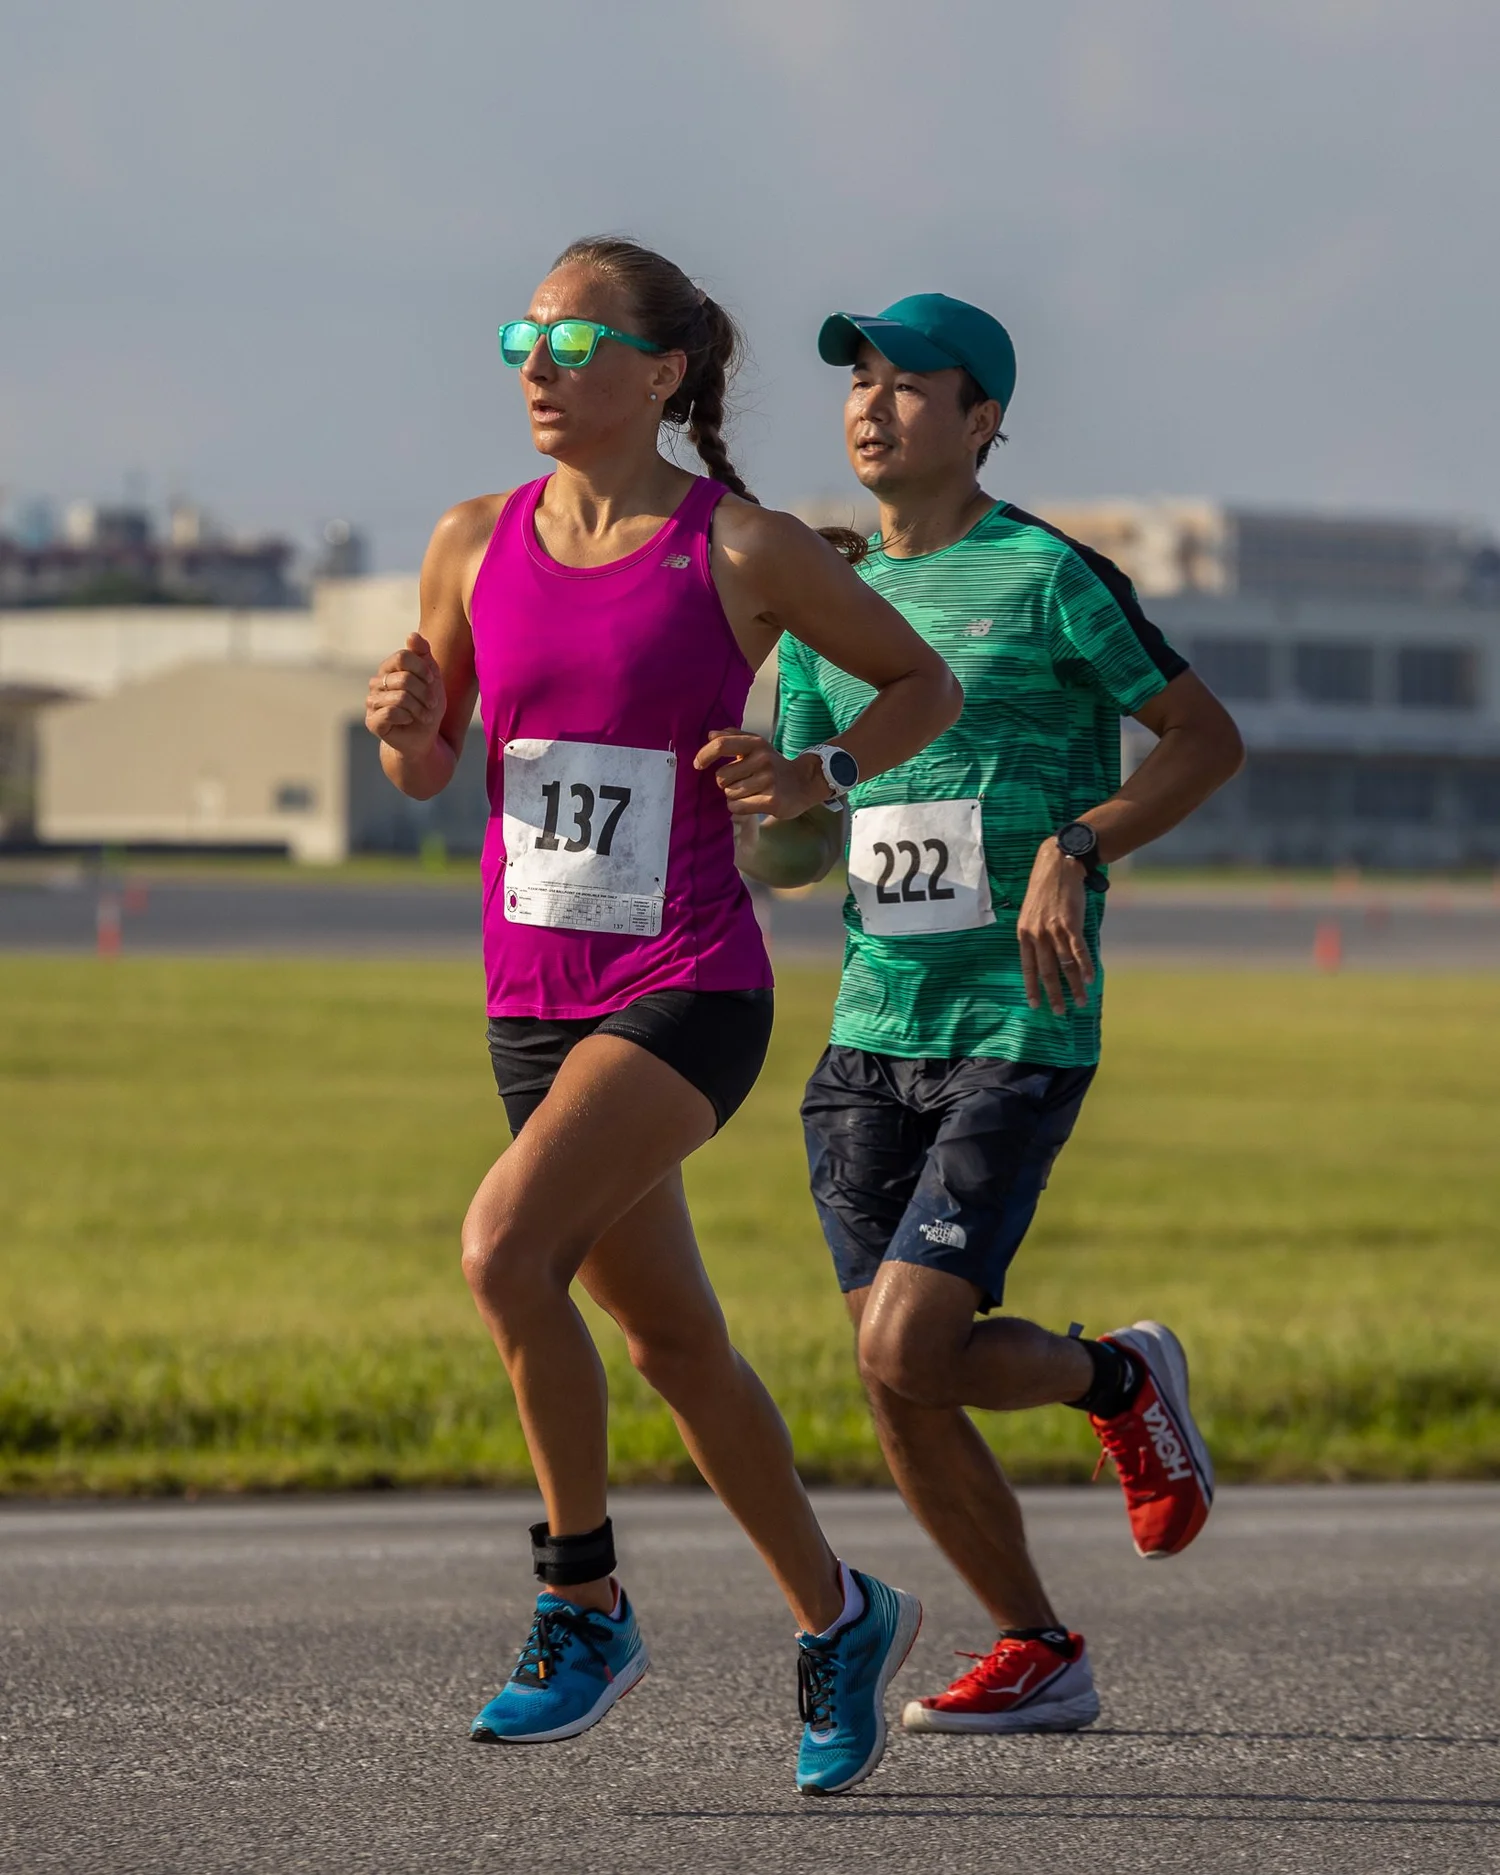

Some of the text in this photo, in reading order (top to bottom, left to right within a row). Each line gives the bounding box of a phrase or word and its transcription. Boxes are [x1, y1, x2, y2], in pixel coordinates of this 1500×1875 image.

[535, 780, 631, 856] 137
[873, 838, 955, 904] 222
[919, 1224, 951, 1237] NORTH
[926, 1231, 950, 1245] FACE
[935, 1219, 953, 1230] THE
[1143, 1401, 1192, 1481] HOKA
